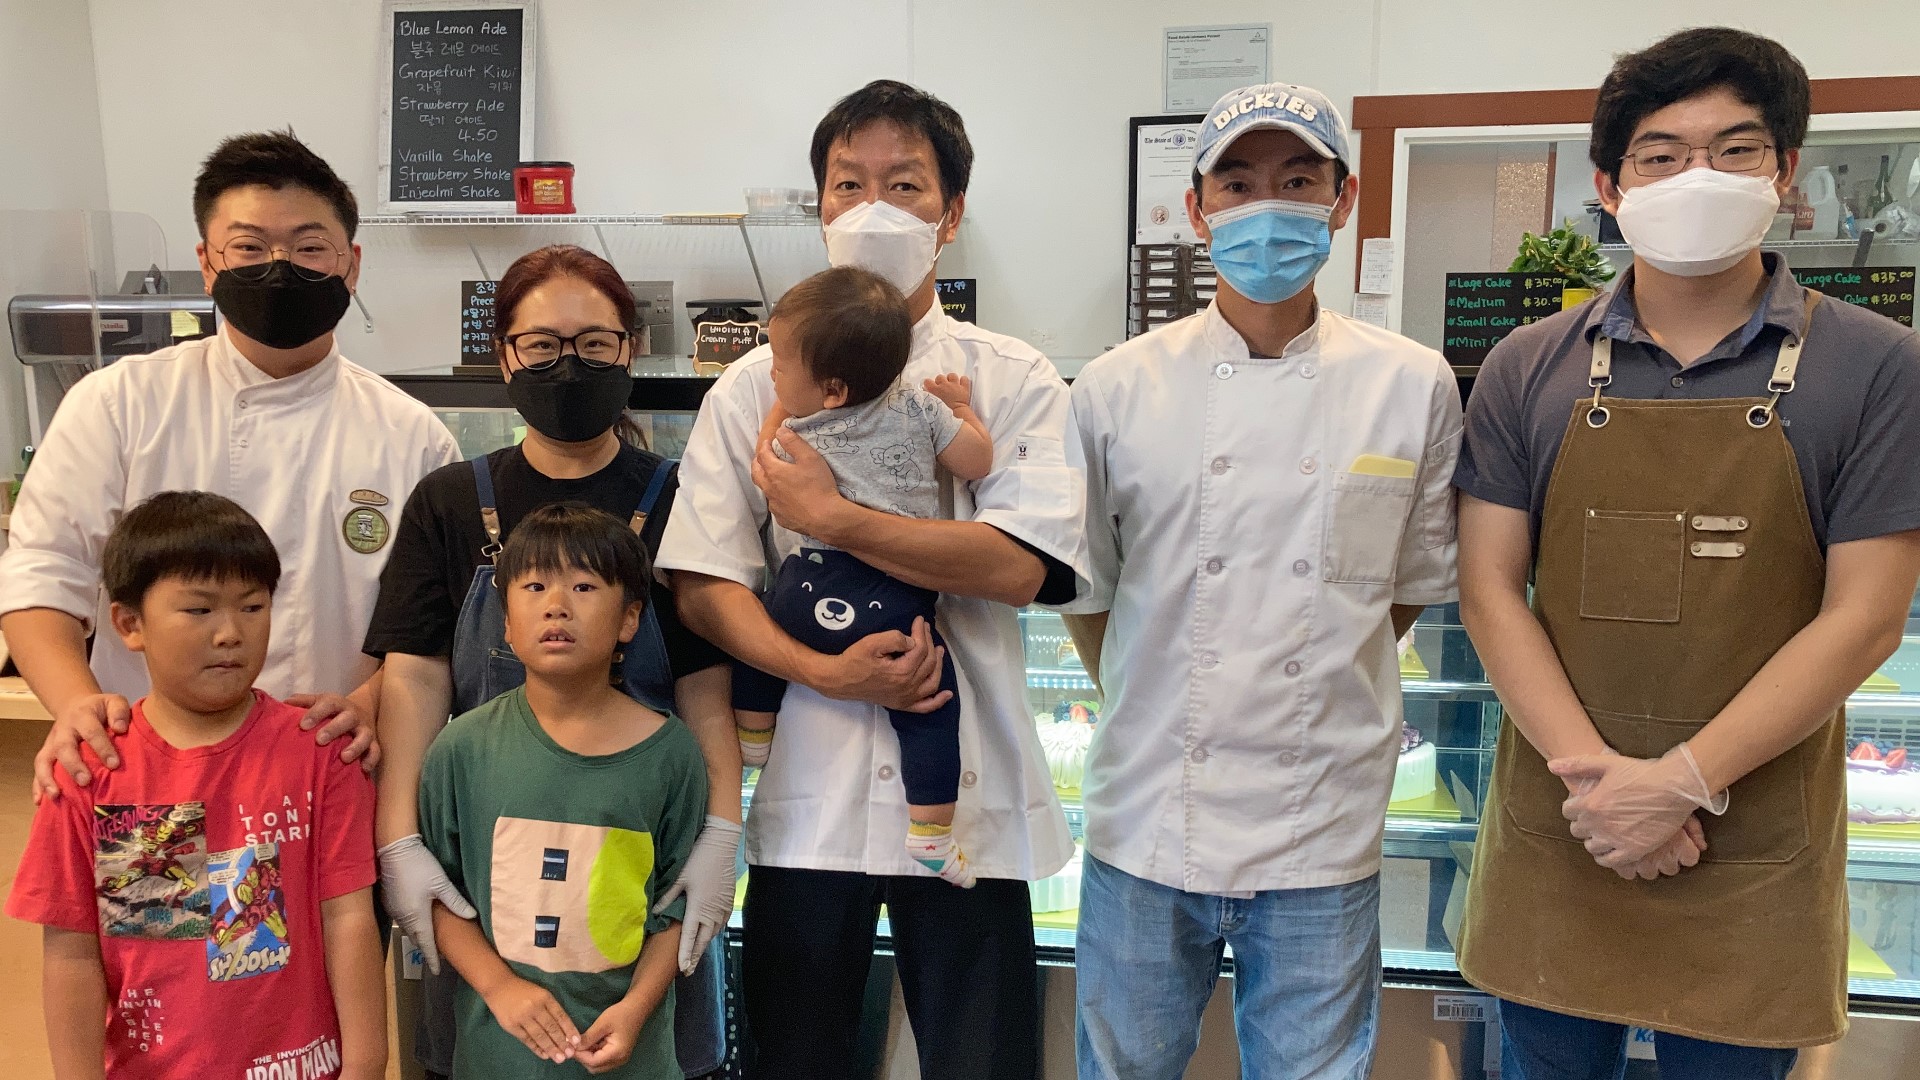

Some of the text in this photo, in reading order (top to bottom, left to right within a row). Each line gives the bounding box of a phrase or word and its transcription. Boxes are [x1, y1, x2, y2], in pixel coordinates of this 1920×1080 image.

[400, 20, 508, 36] Blue Lemon Ade
[410, 41, 501, 59] 블루 레몬 에이드
[399, 62, 517, 82] Grapefruit Kiwi
[416, 81, 512, 96] 자몽 키위
[399, 96, 505, 113] Strawberry Ade
[1213, 91, 1318, 130] DICKIES
[419, 114, 486, 127] 딸기 에이드
[458, 129, 498, 142] 4.50
[398, 148, 493, 163] Vanilla Shake
[399, 166, 511, 182] Strawberry Shake
[398, 185, 501, 200] Injeolmi Shake
[1485, 277, 1512, 288] Cake
[1834, 272, 1861, 284] Cake
[470, 295, 495, 306] Piece
[1844, 294, 1869, 305] Cake
[1490, 316, 1517, 327] Cake
[700, 334, 727, 343] Cream
[240, 806, 312, 831] TON
[253, 1055, 272, 1065] THE
[301, 1039, 341, 1080] MAN
